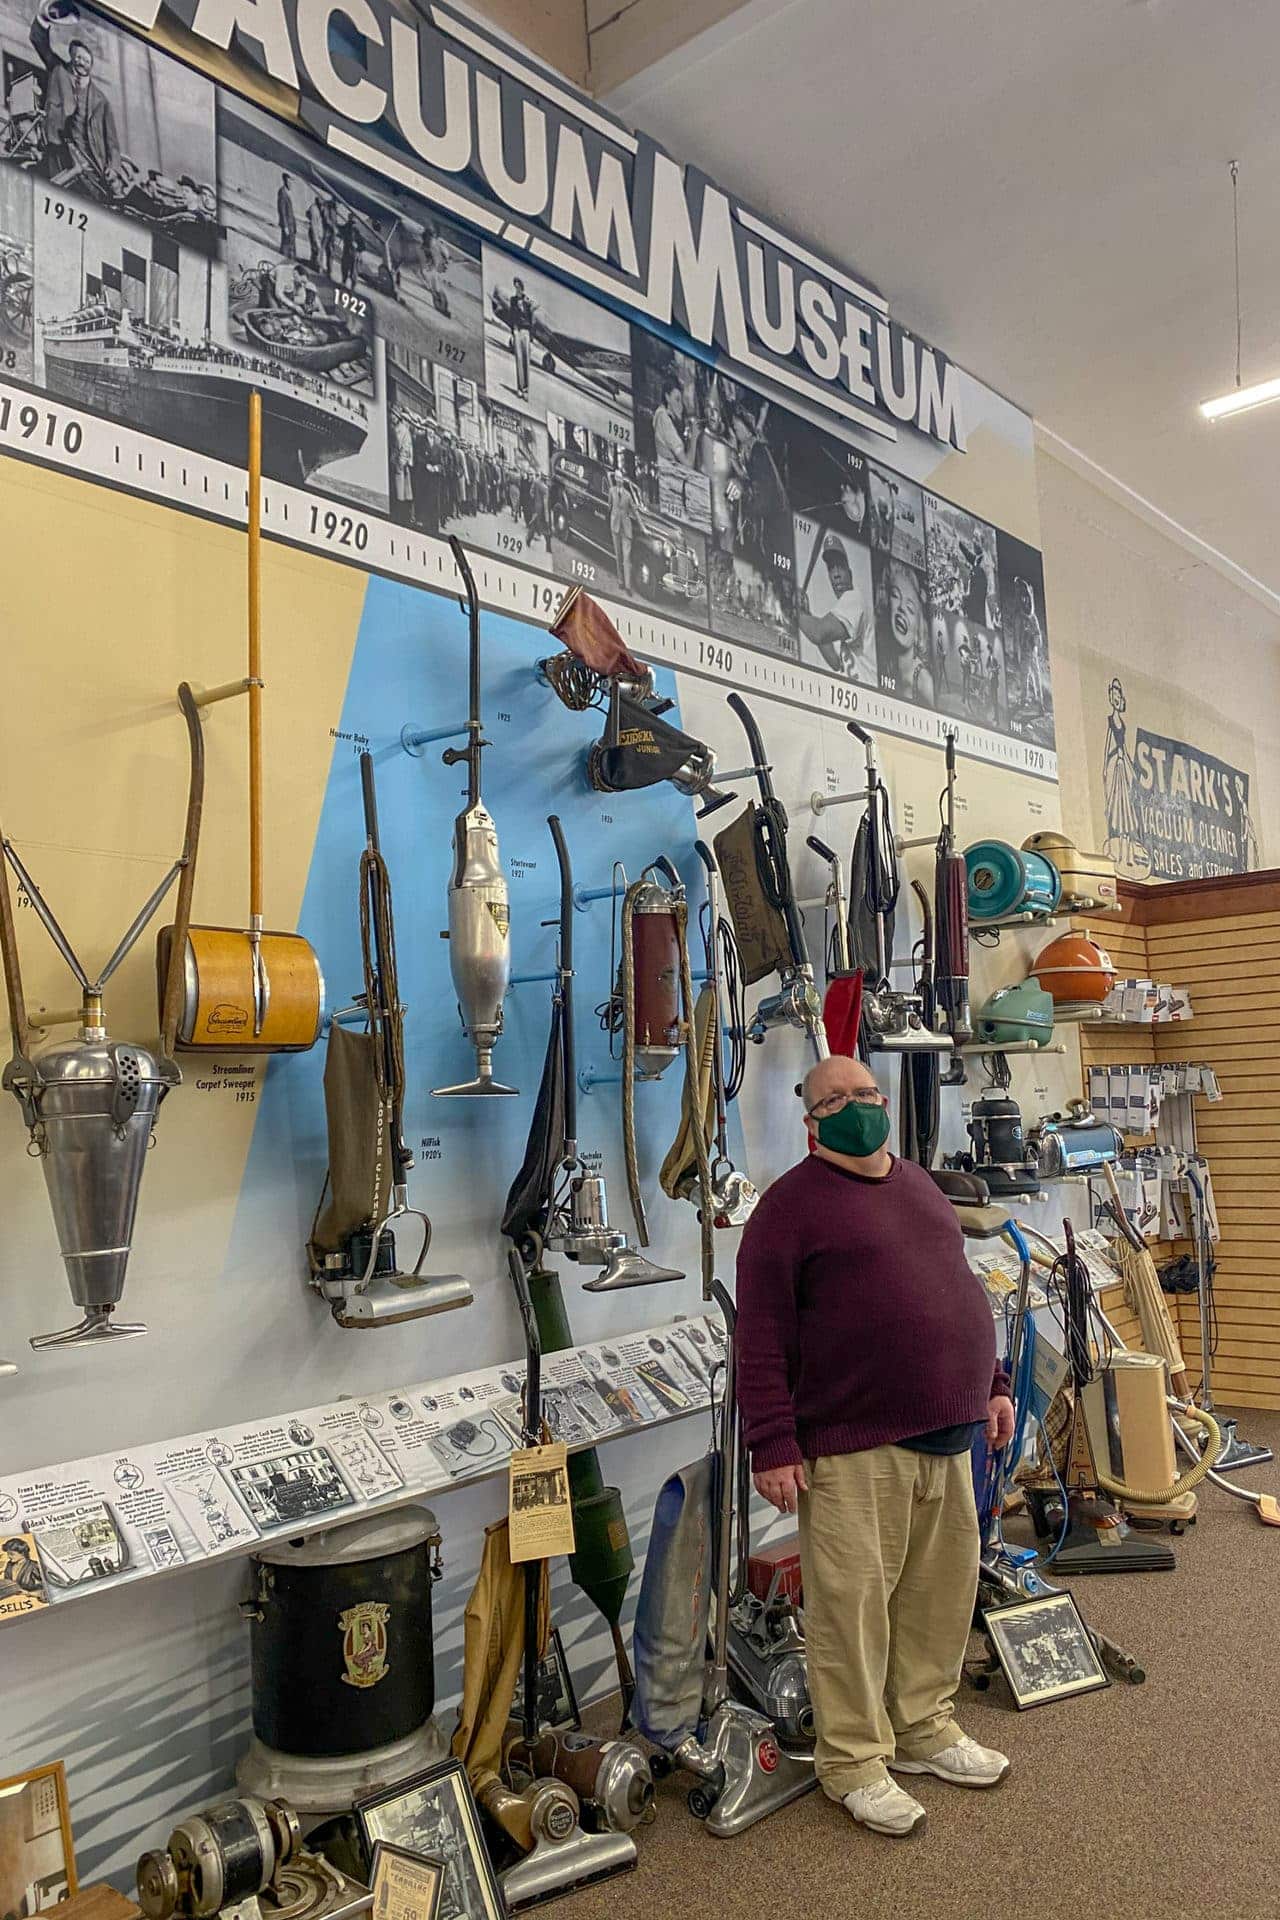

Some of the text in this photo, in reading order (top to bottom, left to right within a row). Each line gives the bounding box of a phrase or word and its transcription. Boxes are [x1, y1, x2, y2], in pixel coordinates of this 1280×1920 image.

[85, 0, 640, 278] ACUUM
[43, 197, 90, 232] 1912
[333, 288, 369, 319] 1922
[437, 340, 468, 365] 1927
[0, 397, 83, 454] 1910
[608, 421, 631, 442] 1932
[309, 506, 369, 551] 1920
[496, 533, 523, 554] 1929
[571, 559, 596, 581] 1932
[773, 553, 791, 570] 1939
[532, 583, 565, 616] 193
[699, 641, 733, 672] 1940
[880, 675, 896, 691] 1962
[829, 686, 858, 712] 1950
[329, 727, 369, 746] Hoover Baby
[936, 719, 960, 744] 1960
[1023, 748, 1044, 769] 1970
[1137, 741, 1233, 817] STARK'S
[1141, 804, 1195, 844] VACUUM
[1199, 820, 1239, 858] CLEANER
[1154, 849, 1184, 876] SALES
[213, 1064, 255, 1075] Streamliner
[196, 1078, 255, 1092] Carpet Sweeper
[236, 1091, 255, 1102] 1915
[422, 1149, 442, 1161] 1920's
[25, 1517, 46, 1529] Ideal
[45, 1511, 76, 1523] Vacuum
[75, 1503, 103, 1516] Cleaner
